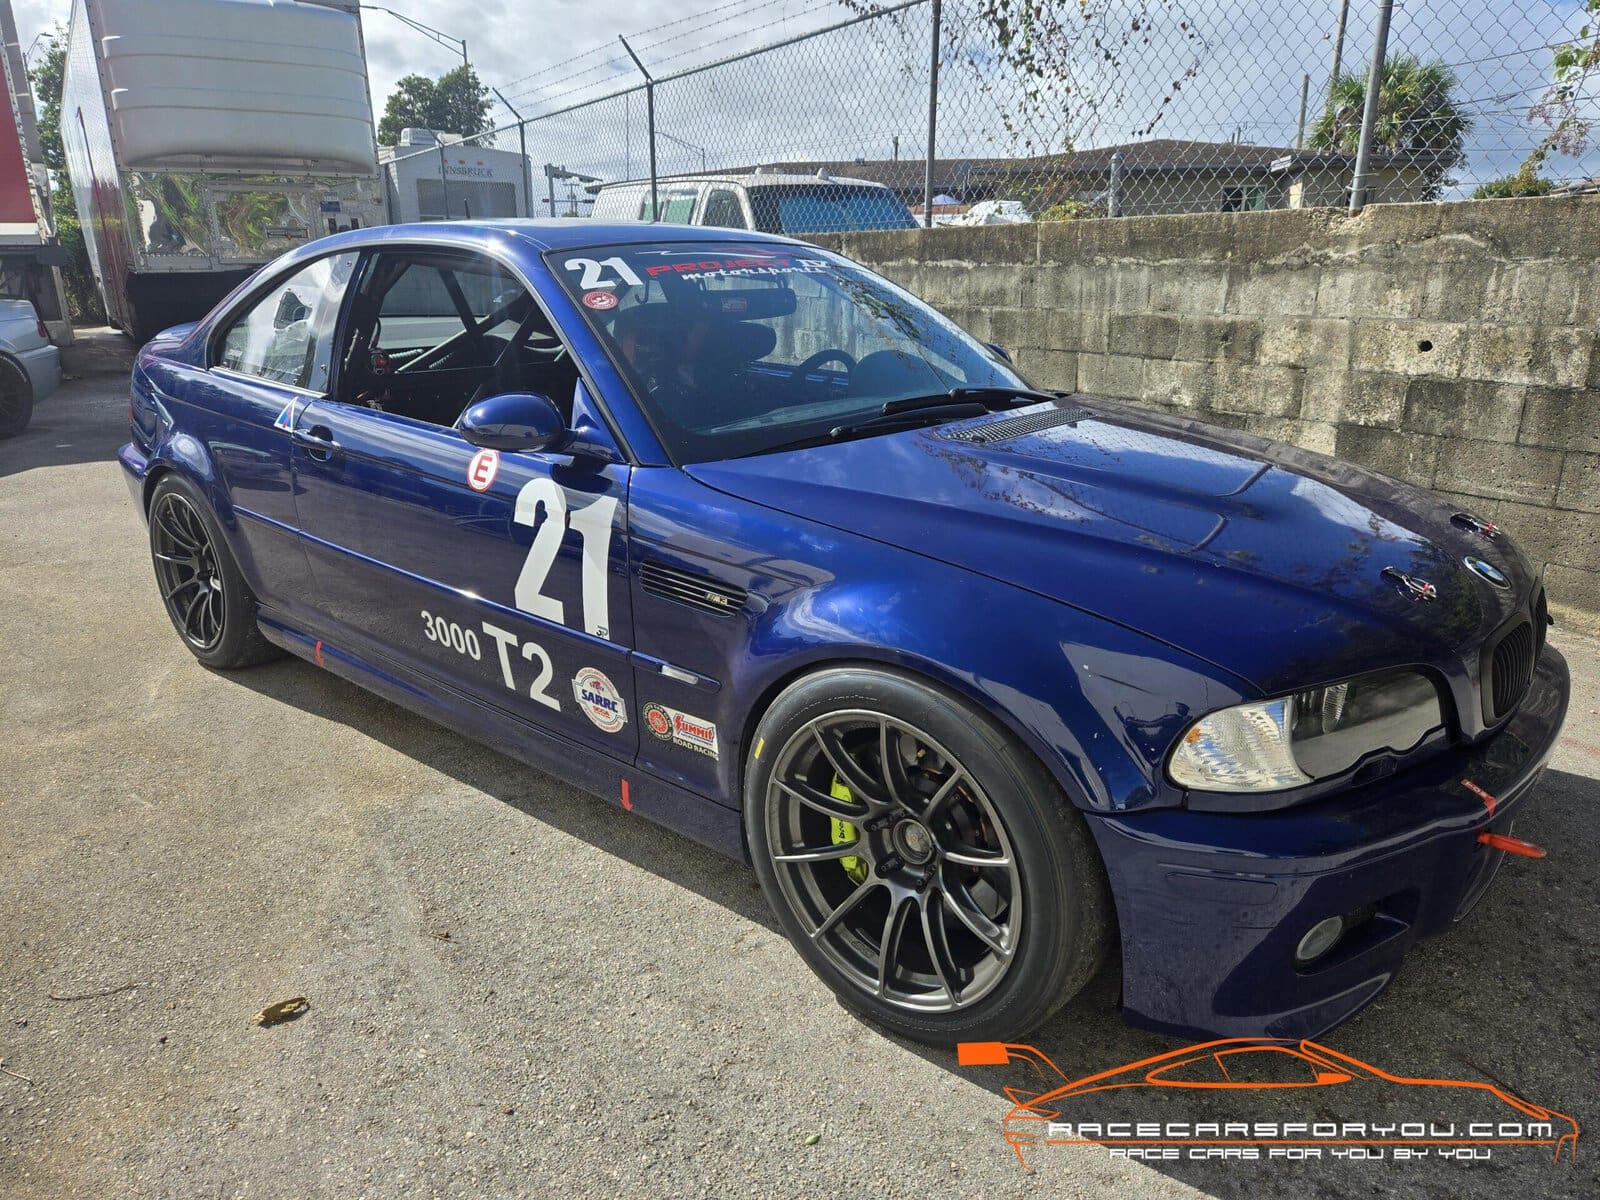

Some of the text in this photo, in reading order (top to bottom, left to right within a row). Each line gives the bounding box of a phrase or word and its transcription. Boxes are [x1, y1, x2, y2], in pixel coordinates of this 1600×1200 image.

[564, 257, 643, 290] 21
[646, 259, 790, 277] PROJECT
[681, 267, 827, 282] motorsports
[473, 455, 493, 483] E
[513, 477, 619, 640] 21
[420, 610, 562, 712] 3000 T2
[581, 688, 618, 713] SARRC
[672, 737, 693, 750] ROAD
[694, 744, 719, 760] RACING
